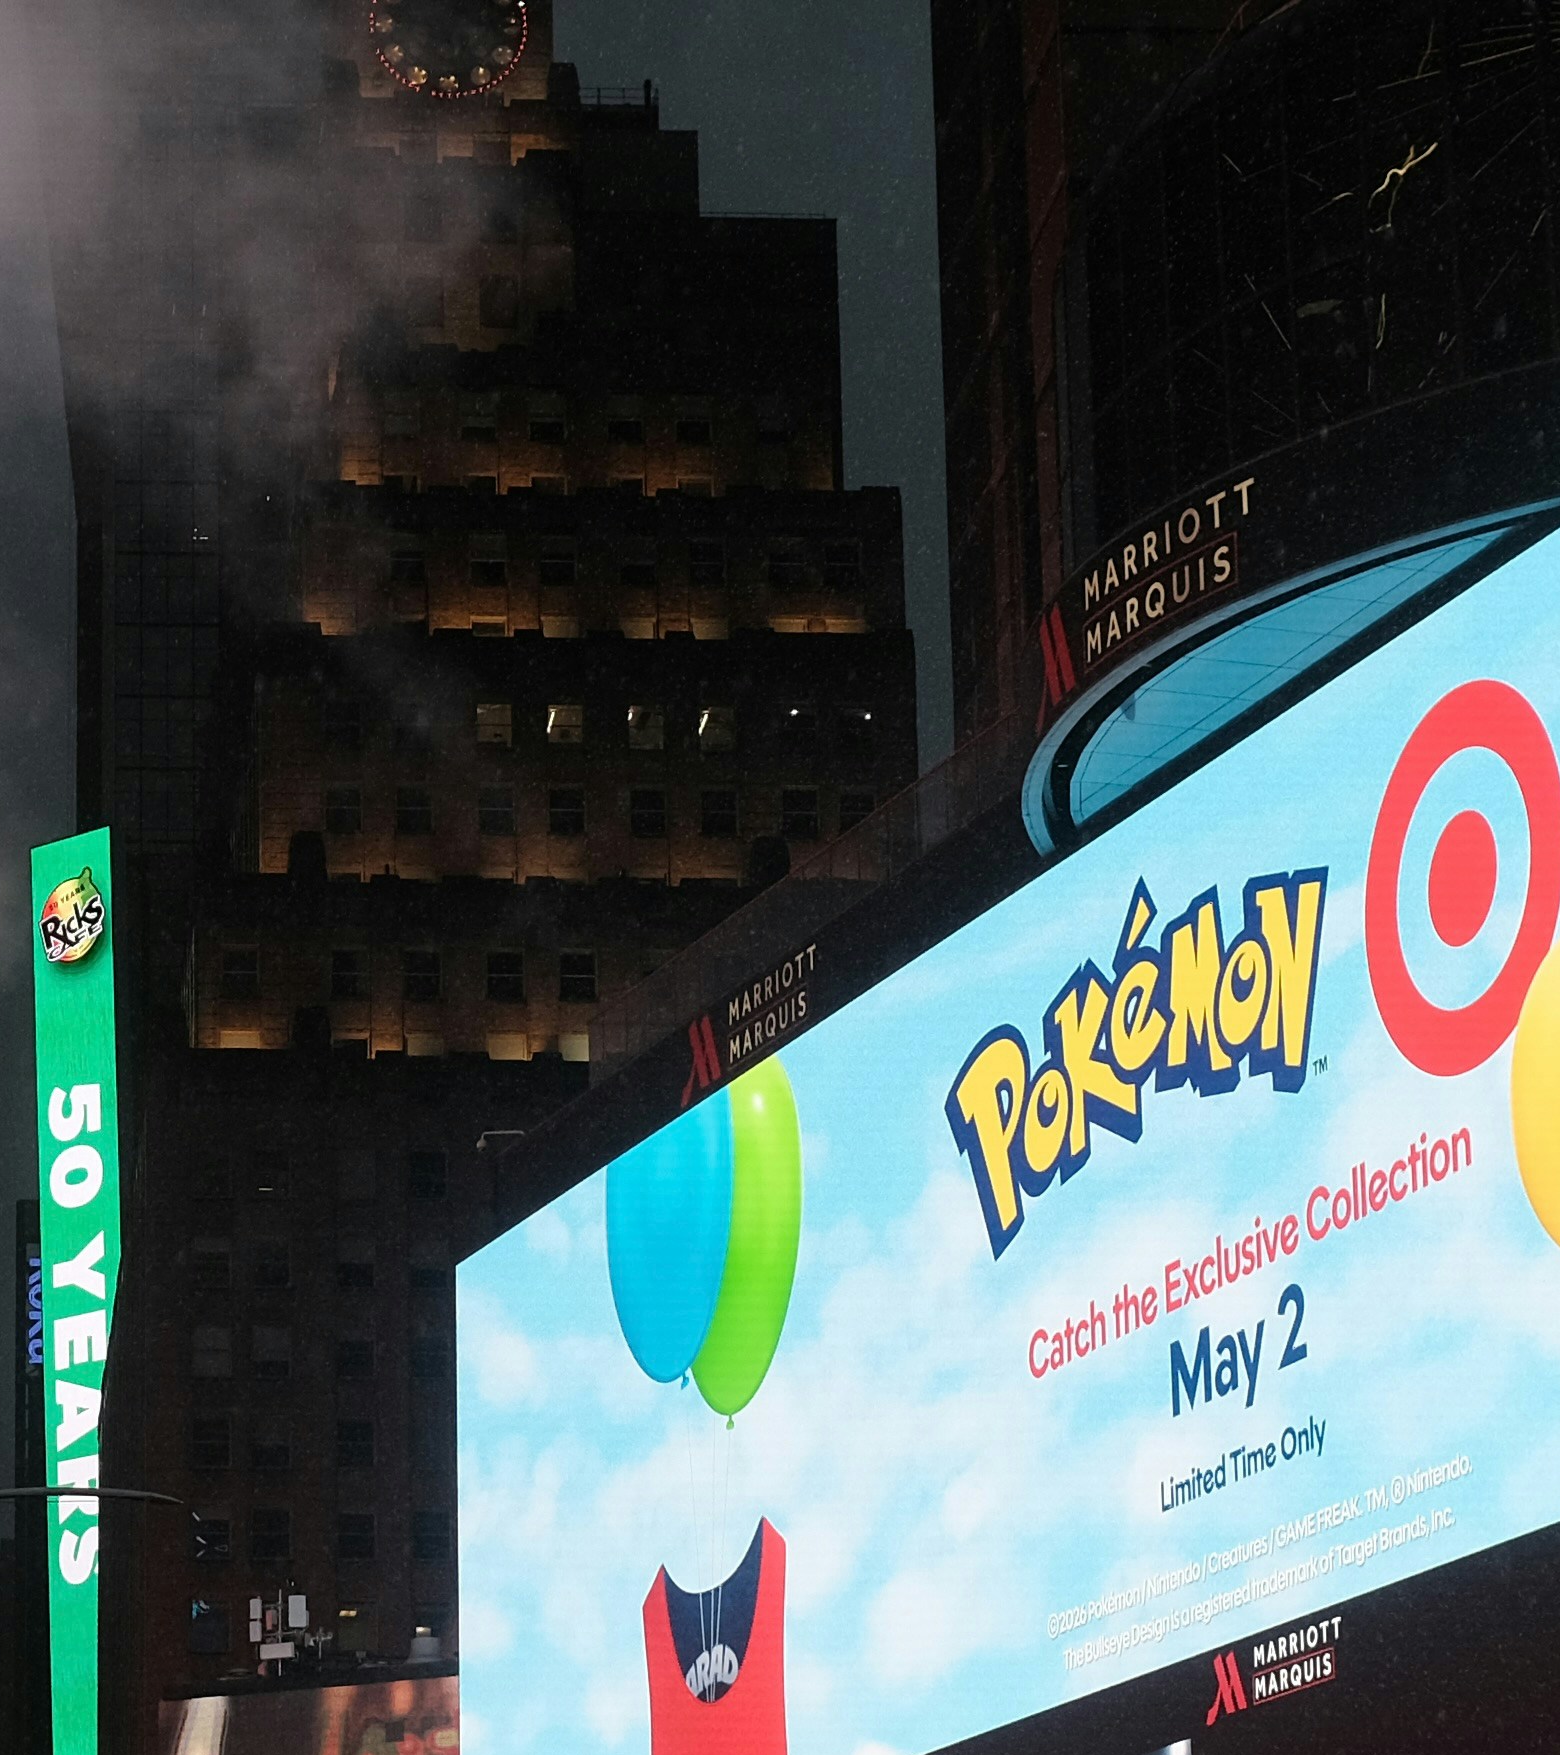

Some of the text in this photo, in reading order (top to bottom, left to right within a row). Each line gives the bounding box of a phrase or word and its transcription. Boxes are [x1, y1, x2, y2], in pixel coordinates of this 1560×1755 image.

[1084, 477, 1255, 612] MARRIOTT
[1086, 545, 1231, 664] MARQUIS
[728, 943, 817, 1026] MARRIOTT
[730, 991, 808, 1064] MARQUIS
[1028, 1126, 1472, 1379] Catch the Exclusive Collection
[47, 1083, 107, 1586] 50 YEARS
[1170, 1283, 1308, 1418] May 2
[1160, 1414, 1326, 1513] Limited Time Only
[1064, 1645, 1084, 1671] The
[1085, 1629, 1131, 1665] Bullseye
[1131, 1613, 1169, 1647] Design
[1190, 1580, 1251, 1626] registered
[1251, 1556, 1318, 1601] trademark
[1318, 1552, 1335, 1574] of
[1335, 1531, 1380, 1568] Target
[1087, 1587, 1141, 1624] Pokémon
[1147, 1560, 1201, 1600] Nintendo
[1209, 1537, 1268, 1575] Creatures
[1275, 1514, 1316, 1549] GAME
[1254, 1617, 1342, 1668] MARRIOTT
[1255, 1653, 1333, 1700] MARQUIS
